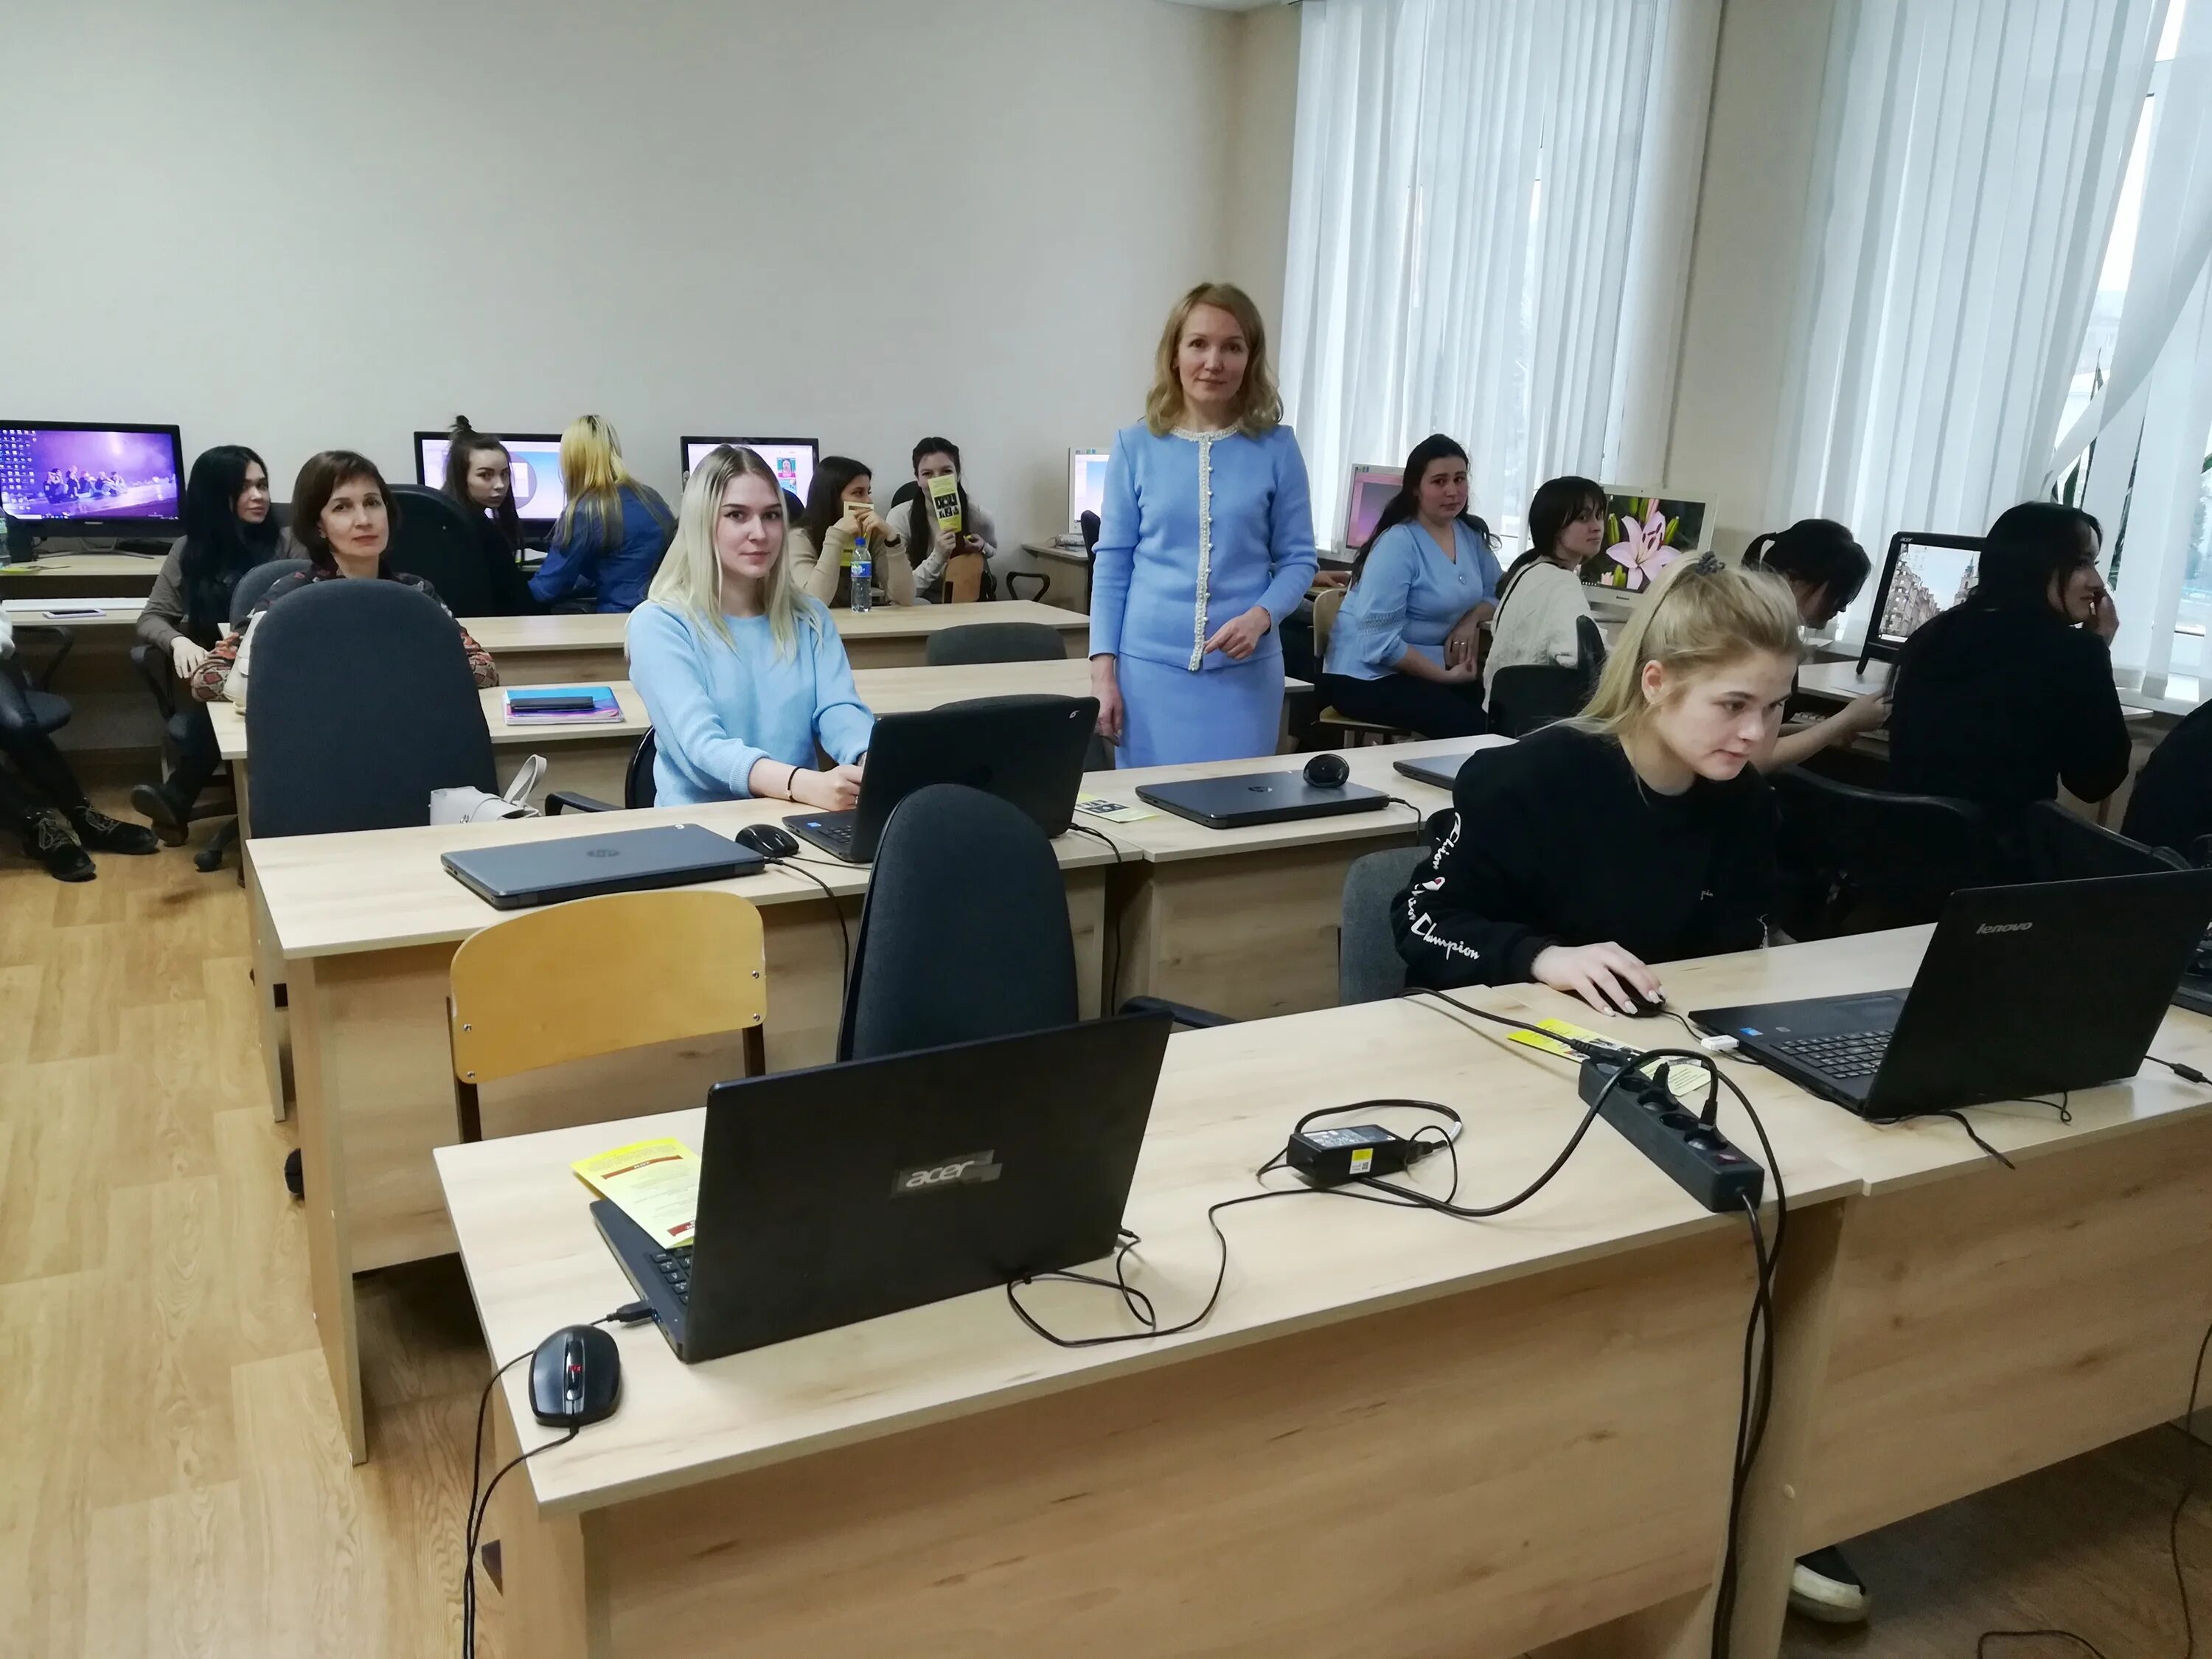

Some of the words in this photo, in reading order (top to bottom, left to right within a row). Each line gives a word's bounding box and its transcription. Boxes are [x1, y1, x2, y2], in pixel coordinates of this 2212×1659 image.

[1411, 912, 1481, 961] Champion
[1976, 922, 2034, 934] lenovo
[905, 1161, 975, 1188] acer
